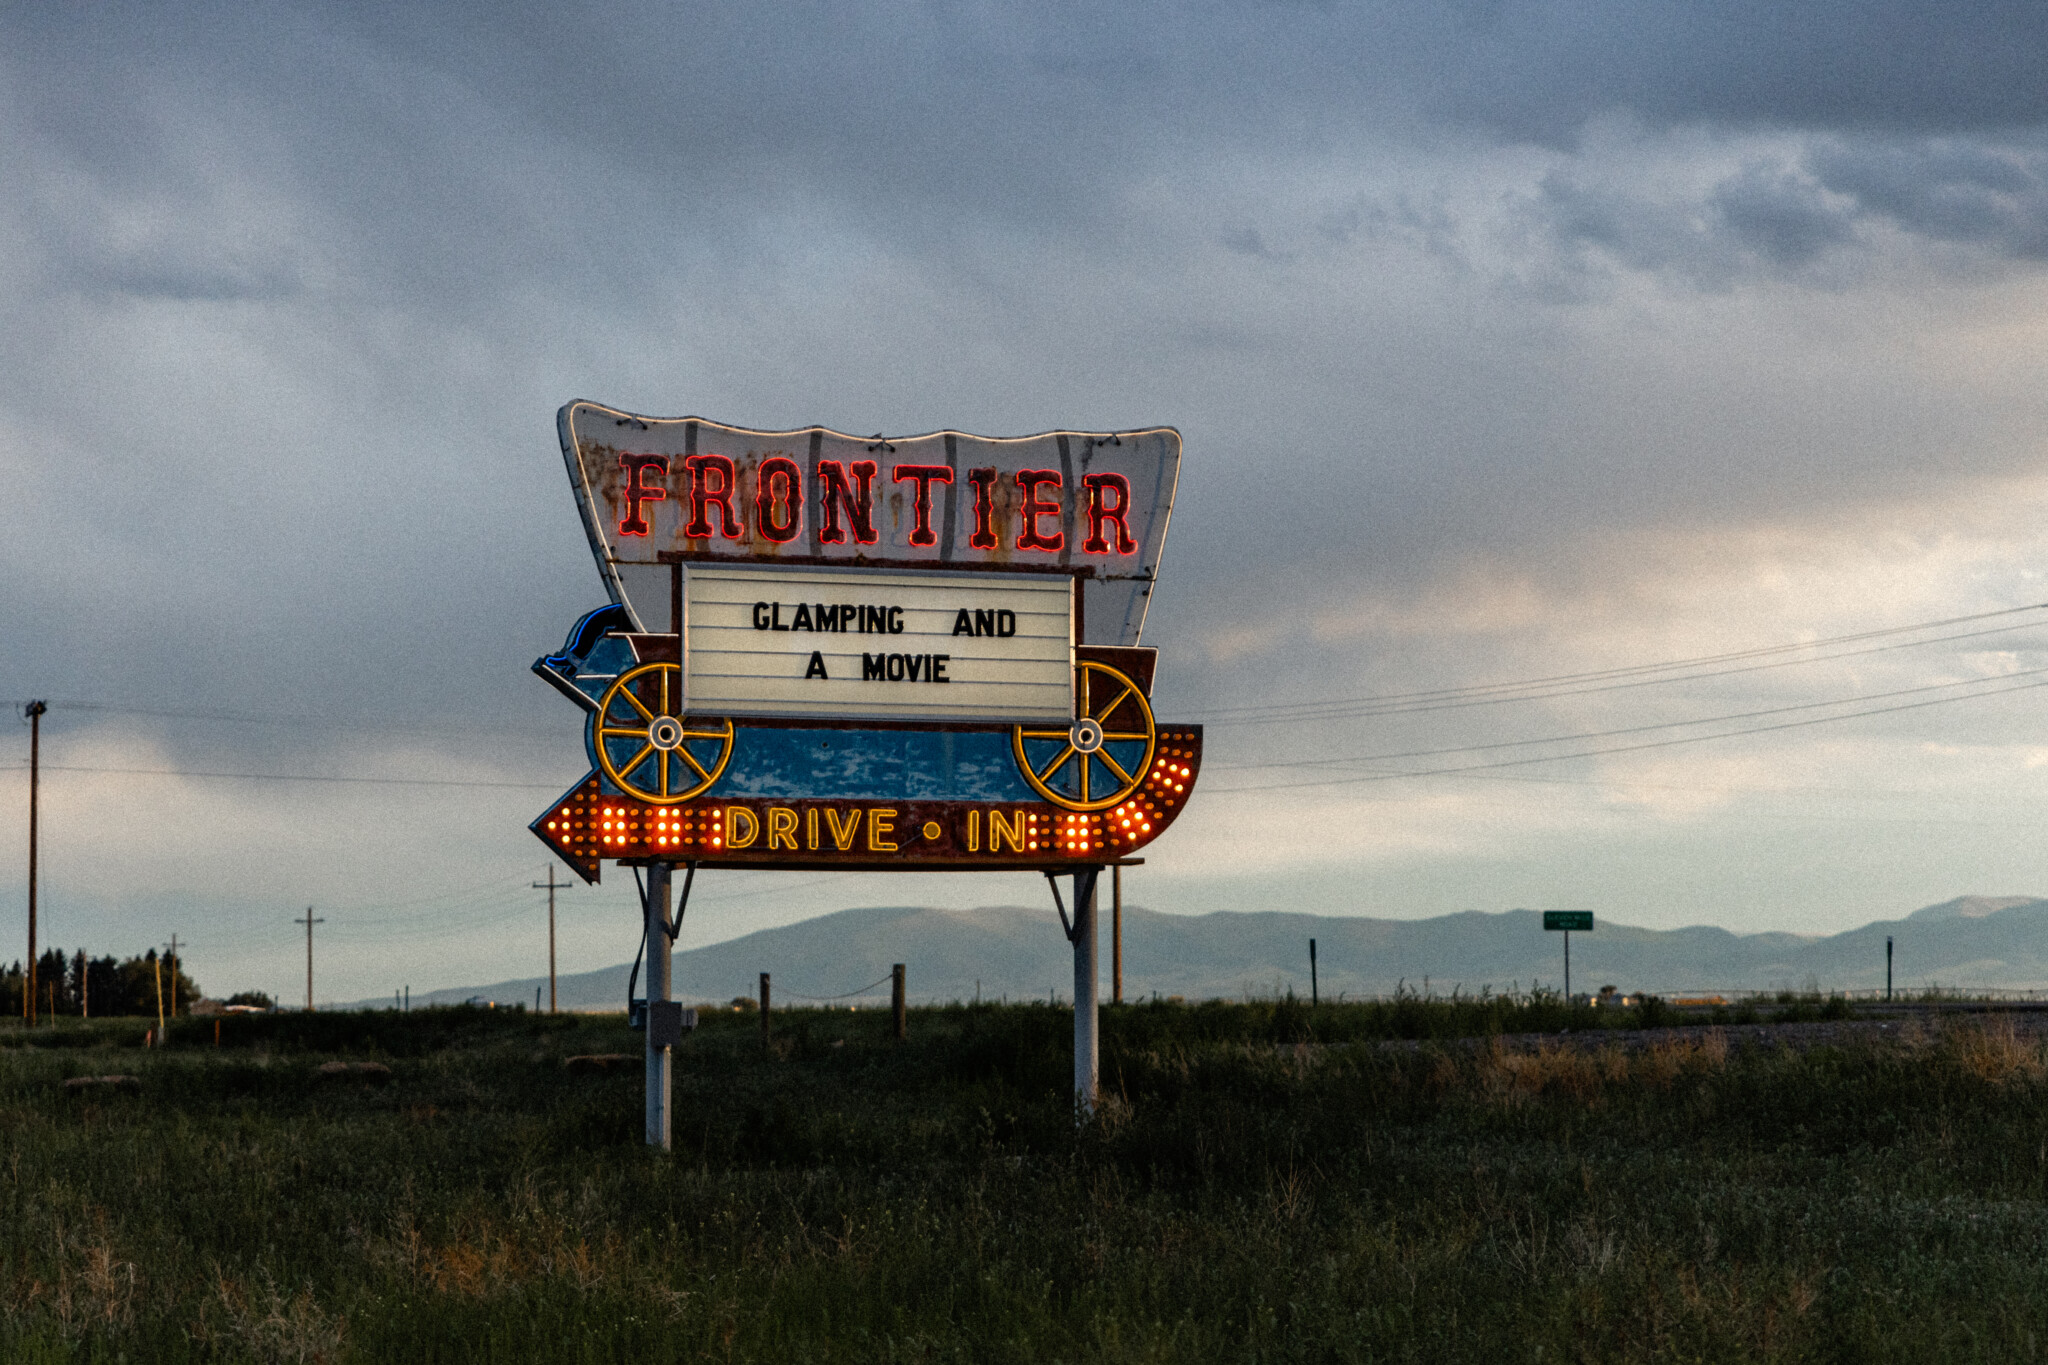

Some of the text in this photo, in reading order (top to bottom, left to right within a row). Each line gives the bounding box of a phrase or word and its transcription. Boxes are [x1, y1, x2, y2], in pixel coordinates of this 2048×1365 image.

[618, 452, 1138, 555] FRONTIER
[753, 601, 1016, 638] GLAMPING AND
[805, 650, 950, 683] A MOVIE
[725, 806, 1026, 853] DRIVE IN
